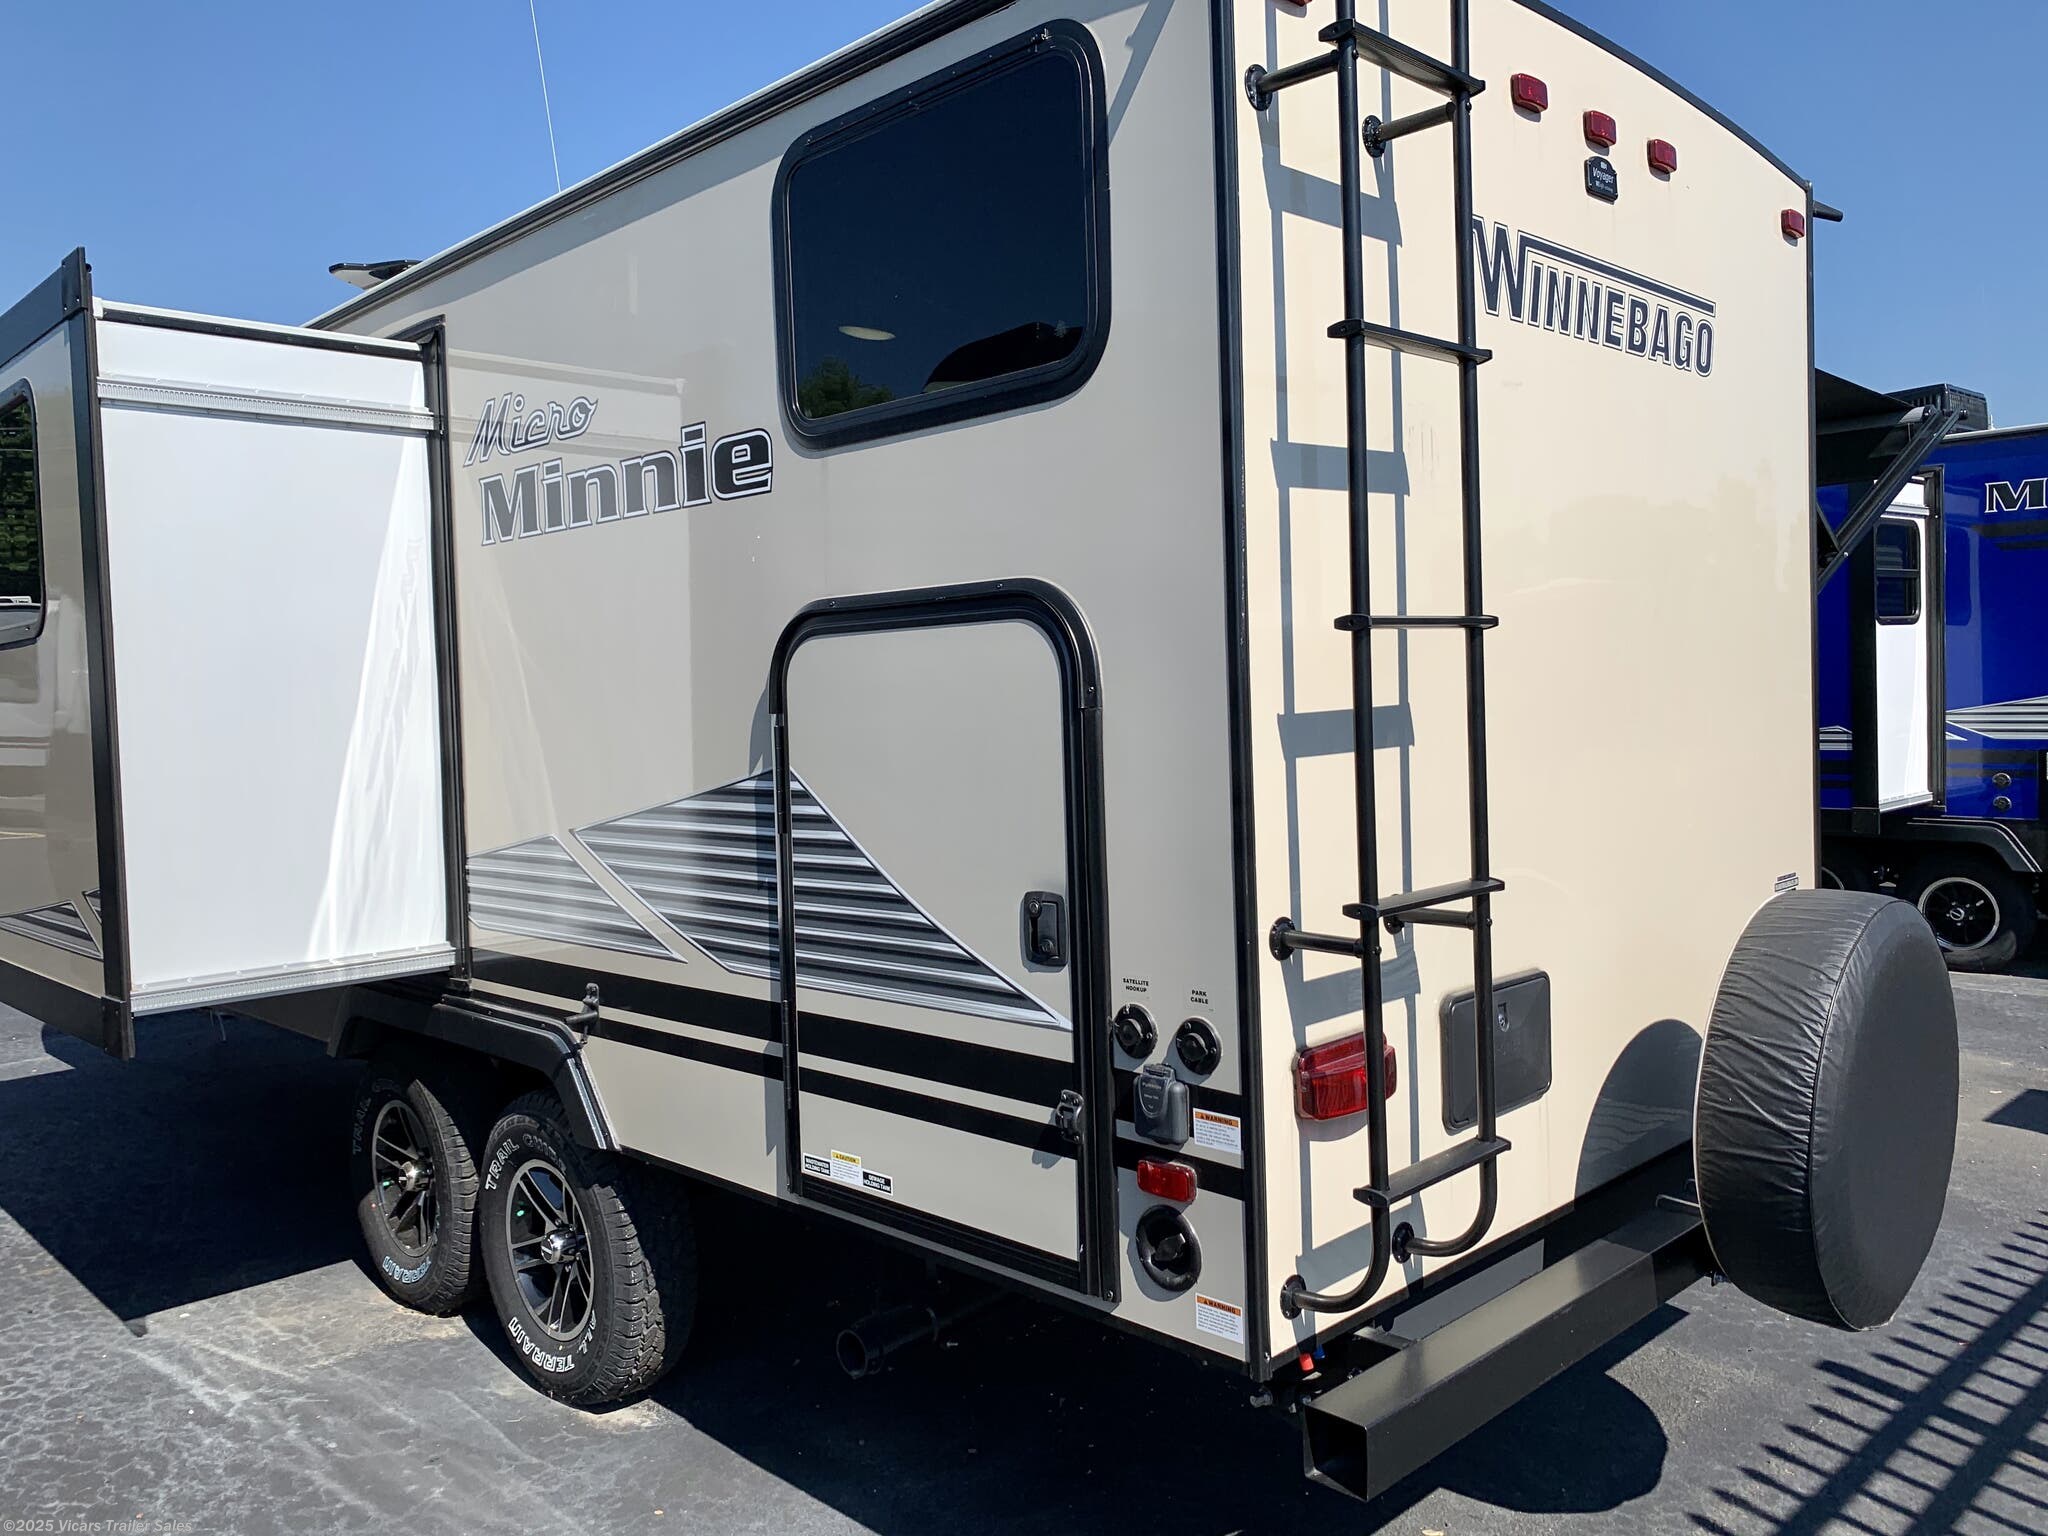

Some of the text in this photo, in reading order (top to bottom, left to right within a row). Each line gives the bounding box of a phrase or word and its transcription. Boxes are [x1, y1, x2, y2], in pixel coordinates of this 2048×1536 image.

[1592, 166, 1614, 184] Voyager
[1472, 214, 1716, 378] WINNEBAGO
[463, 392, 598, 467] Micro
[479, 421, 774, 547] Minnie
[1122, 977, 1149, 987] SATELLITE
[1125, 984, 1147, 993] HOOKUP
[1190, 996, 1209, 1005] CABLE
[1191, 989, 1207, 997] PARK
[1205, 1113, 1233, 1126] WARNING
[485, 1139, 520, 1190] TRAIL
[1208, 1299, 1236, 1314] WARNING
[508, 1316, 575, 1373] TERRAIN
